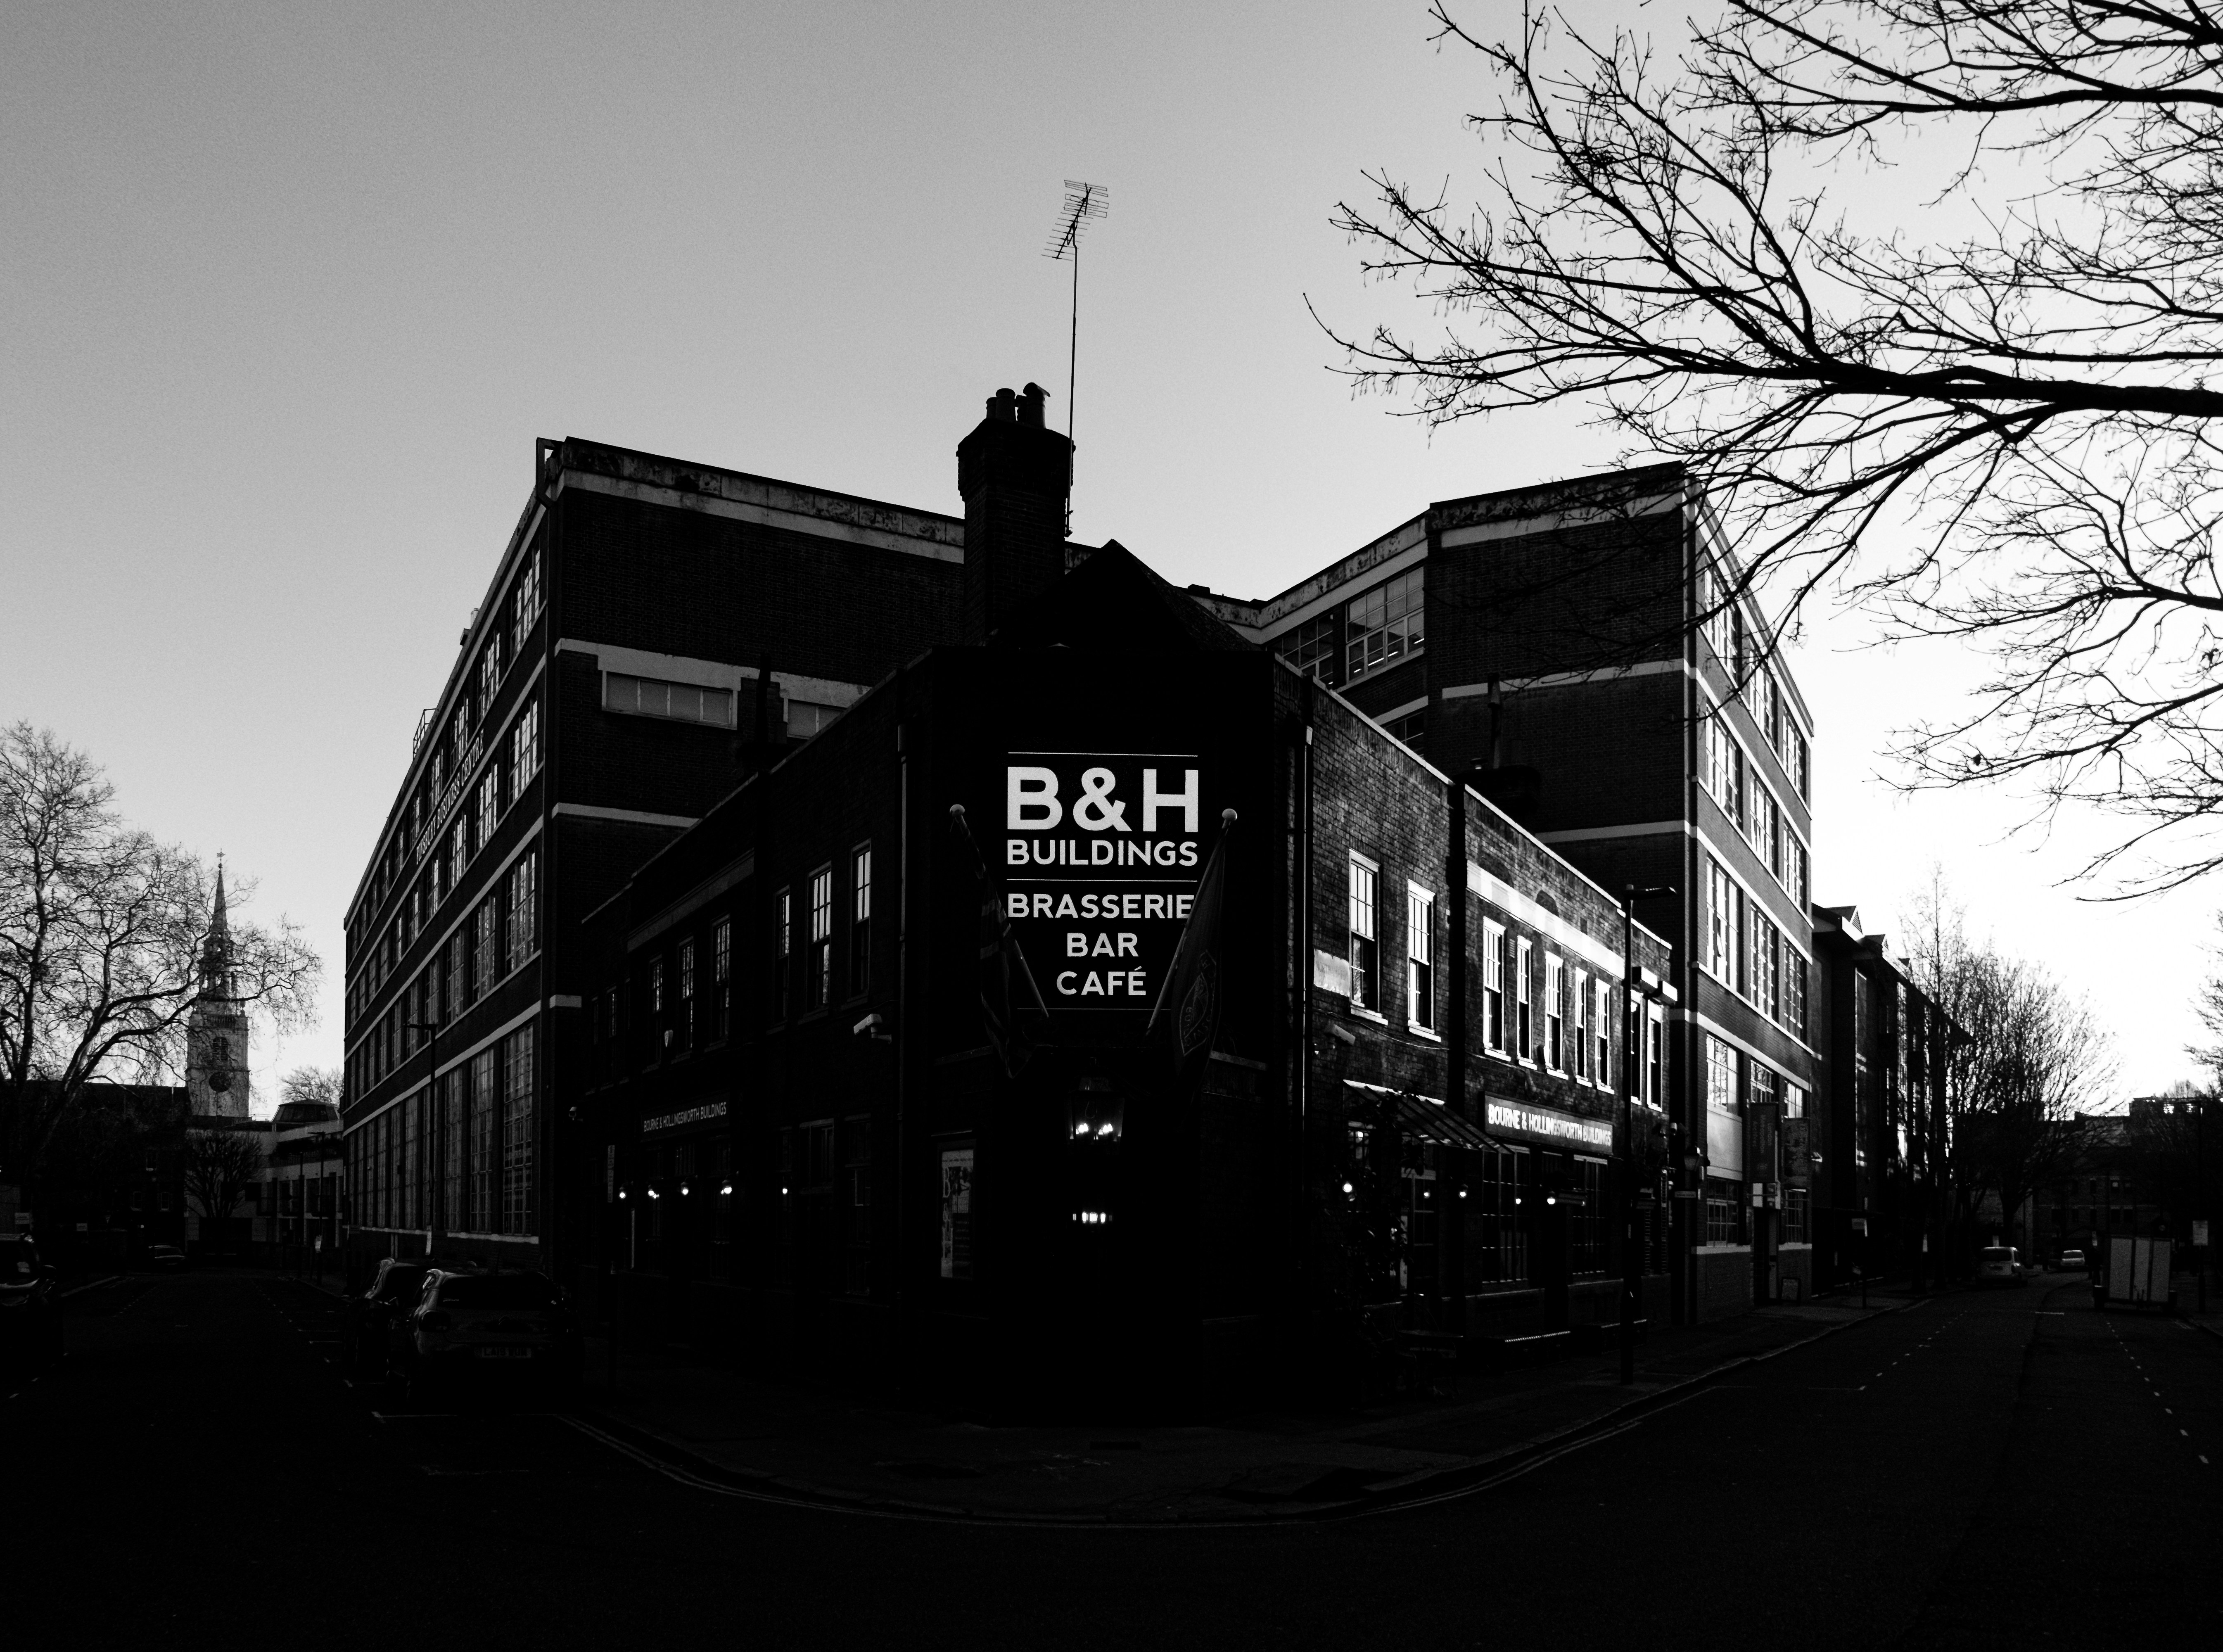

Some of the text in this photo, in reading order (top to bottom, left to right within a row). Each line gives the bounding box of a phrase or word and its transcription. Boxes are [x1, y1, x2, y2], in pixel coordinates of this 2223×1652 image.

[437, 771, 460, 829] BUSINESS
[461, 728, 484, 787] CENTRE
[1007, 839, 1198, 867] BUILDINGS
[1008, 893, 1195, 919] BRASSERIE
[1067, 933, 1139, 957] BAR
[1056, 966, 1146, 996] CAFÉ
[644, 1117, 659, 1132] BOURNE
[663, 1107, 700, 1128] HOLLINGSWORTH
[700, 1101, 726, 1120] BUILDINGS
[1488, 1103, 1611, 1146] BOURNE & HOLLINGSWORTH BUILDINGS
